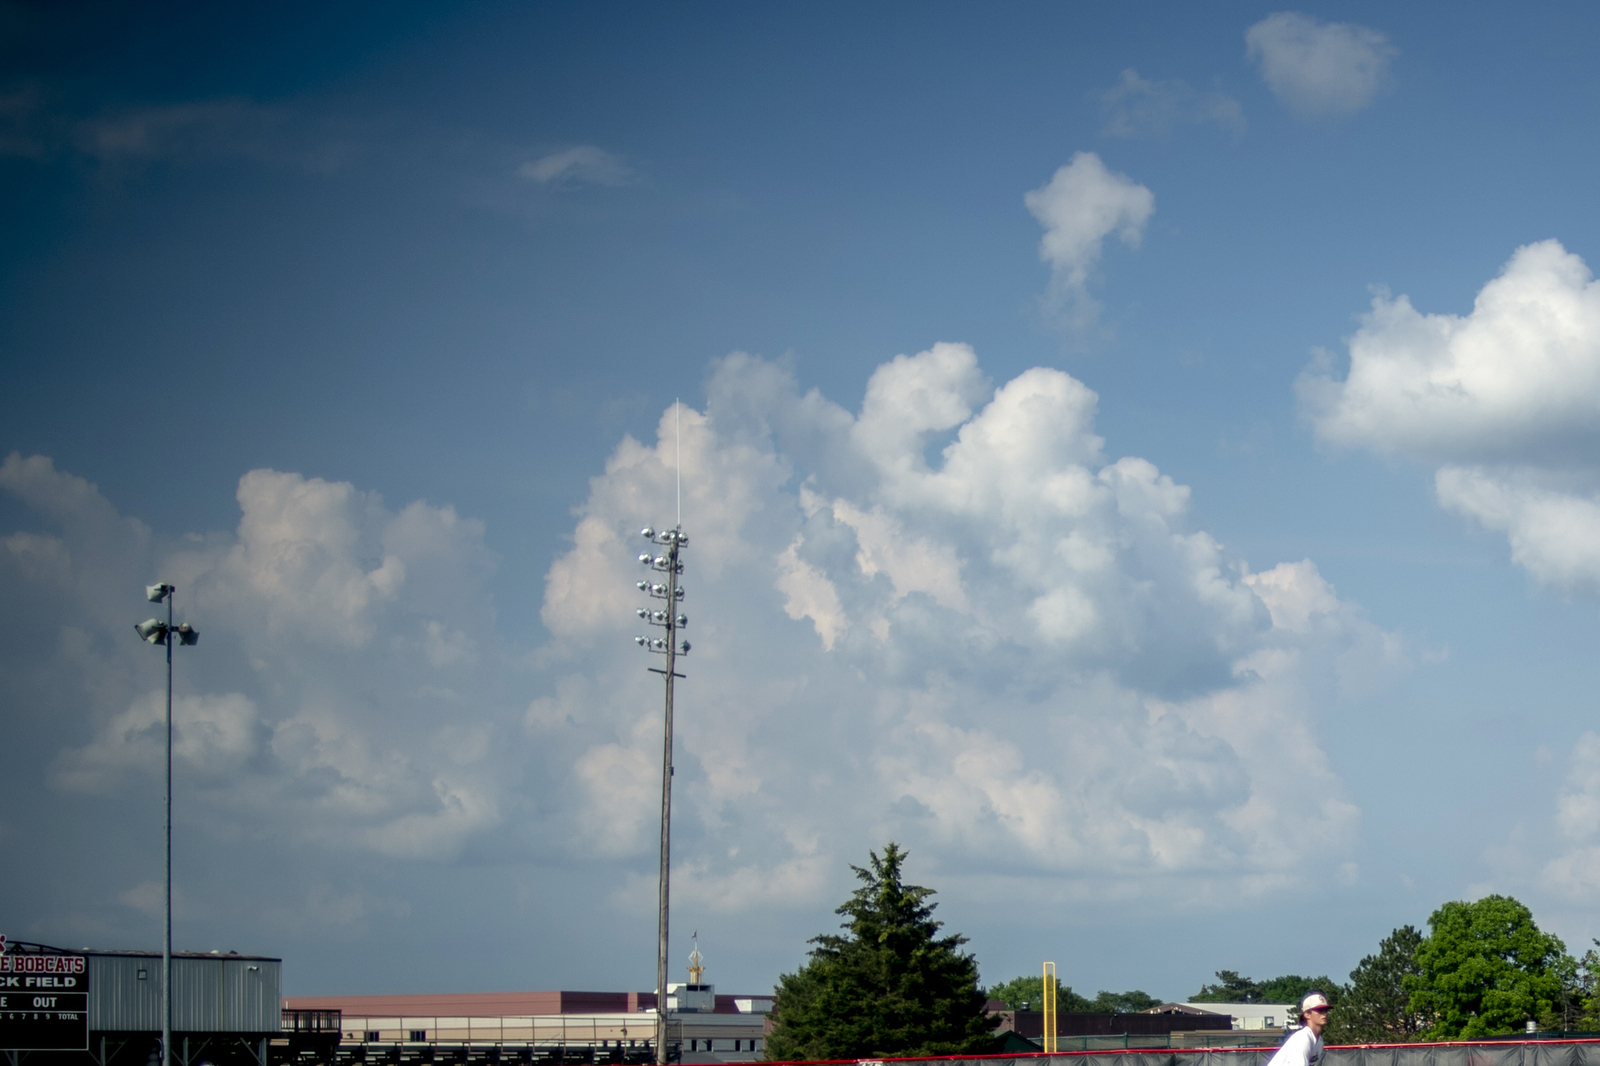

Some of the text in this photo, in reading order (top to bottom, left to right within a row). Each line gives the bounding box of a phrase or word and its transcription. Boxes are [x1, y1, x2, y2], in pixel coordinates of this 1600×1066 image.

[13, 956, 85, 973] BOBCATS
[25, 977, 77, 987] FIELD
[33, 997, 58, 1008] OUT
